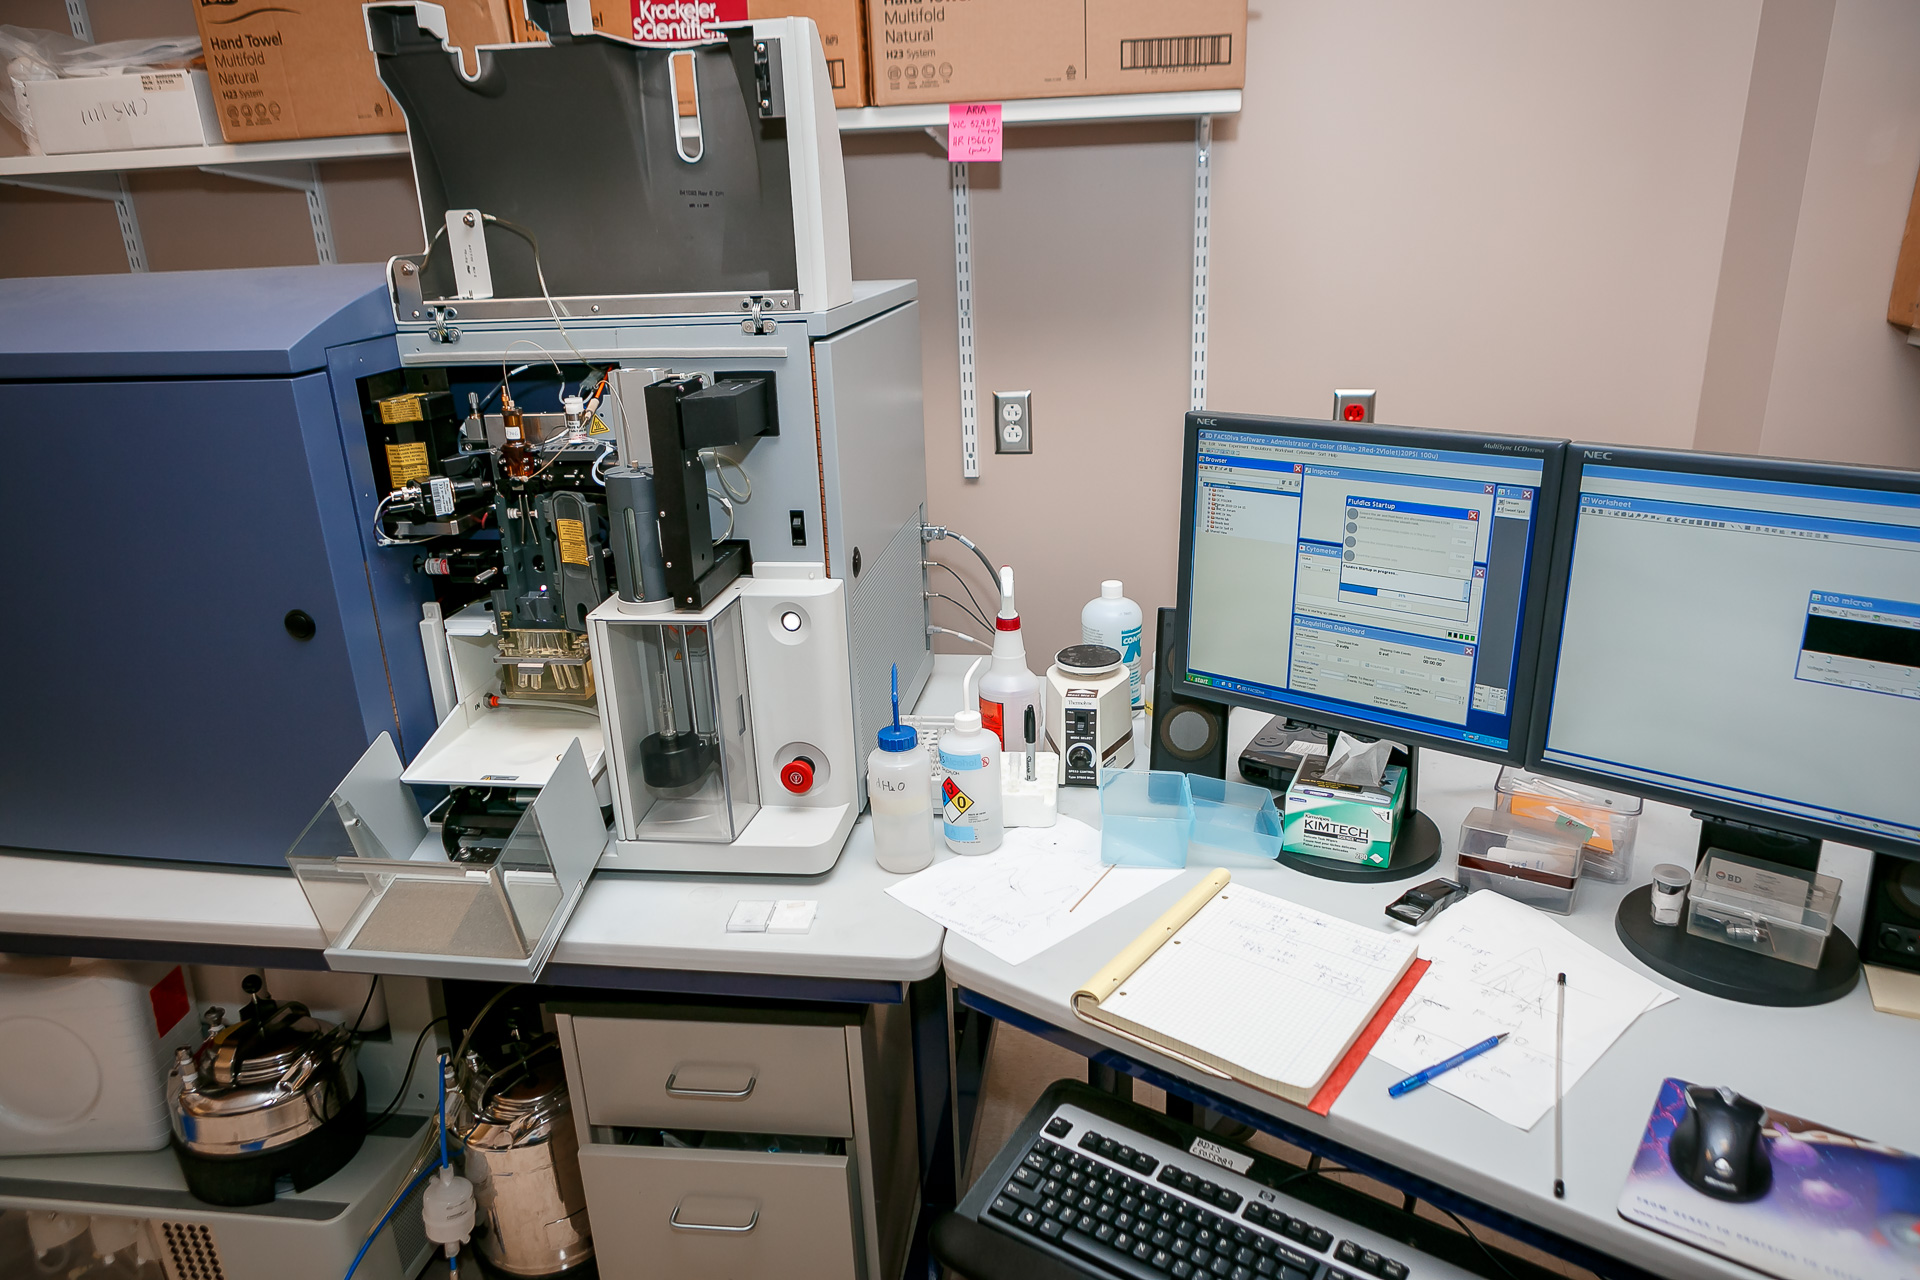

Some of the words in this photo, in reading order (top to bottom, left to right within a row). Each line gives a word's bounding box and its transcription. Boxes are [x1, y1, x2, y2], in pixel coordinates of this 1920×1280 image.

[639, 0, 717, 20] Krackeler
[884, 6, 945, 25] Multifold
[210, 33, 244, 51] Hand
[247, 31, 284, 48] Towel
[885, 27, 934, 44] Natural
[214, 52, 267, 69] Multifold
[886, 50, 904, 60] H23
[906, 50, 936, 61] System
[218, 70, 260, 87] Natural
[222, 89, 238, 100] H23
[239, 88, 264, 99] System
[966, 105, 987, 115] ARIA
[953, 119, 966, 128] WC
[1196, 418, 1217, 426] NEC
[1240, 435, 1265, 444] Software
[1270, 438, 1310, 448] Administrator
[1311, 442, 1335, 450] (9-color
[1483, 443, 1512, 451] MultiSync
[1205, 456, 1228, 464] Browser
[1584, 451, 1612, 460] NEC
[1312, 467, 1340, 476] Inspector
[1347, 499, 1371, 507] Fluidics
[1372, 501, 1396, 510] Startup
[1591, 498, 1632, 508] Worksheet
[1306, 545, 1338, 555] Cytometer
[1823, 595, 1840, 603] 100
[1842, 598, 1873, 608] micron
[1301, 619, 1333, 629] Acquisition
[1334, 624, 1365, 635] Dashboard
[1194, 677, 1209, 685] start
[946, 782, 954, 795] 3
[957, 796, 966, 809] 0
[1305, 814, 1330, 822] Kimwipes
[1386, 811, 1390, 820] 1
[1304, 819, 1369, 839] KIMTECH
[1727, 873, 1742, 883] BD
